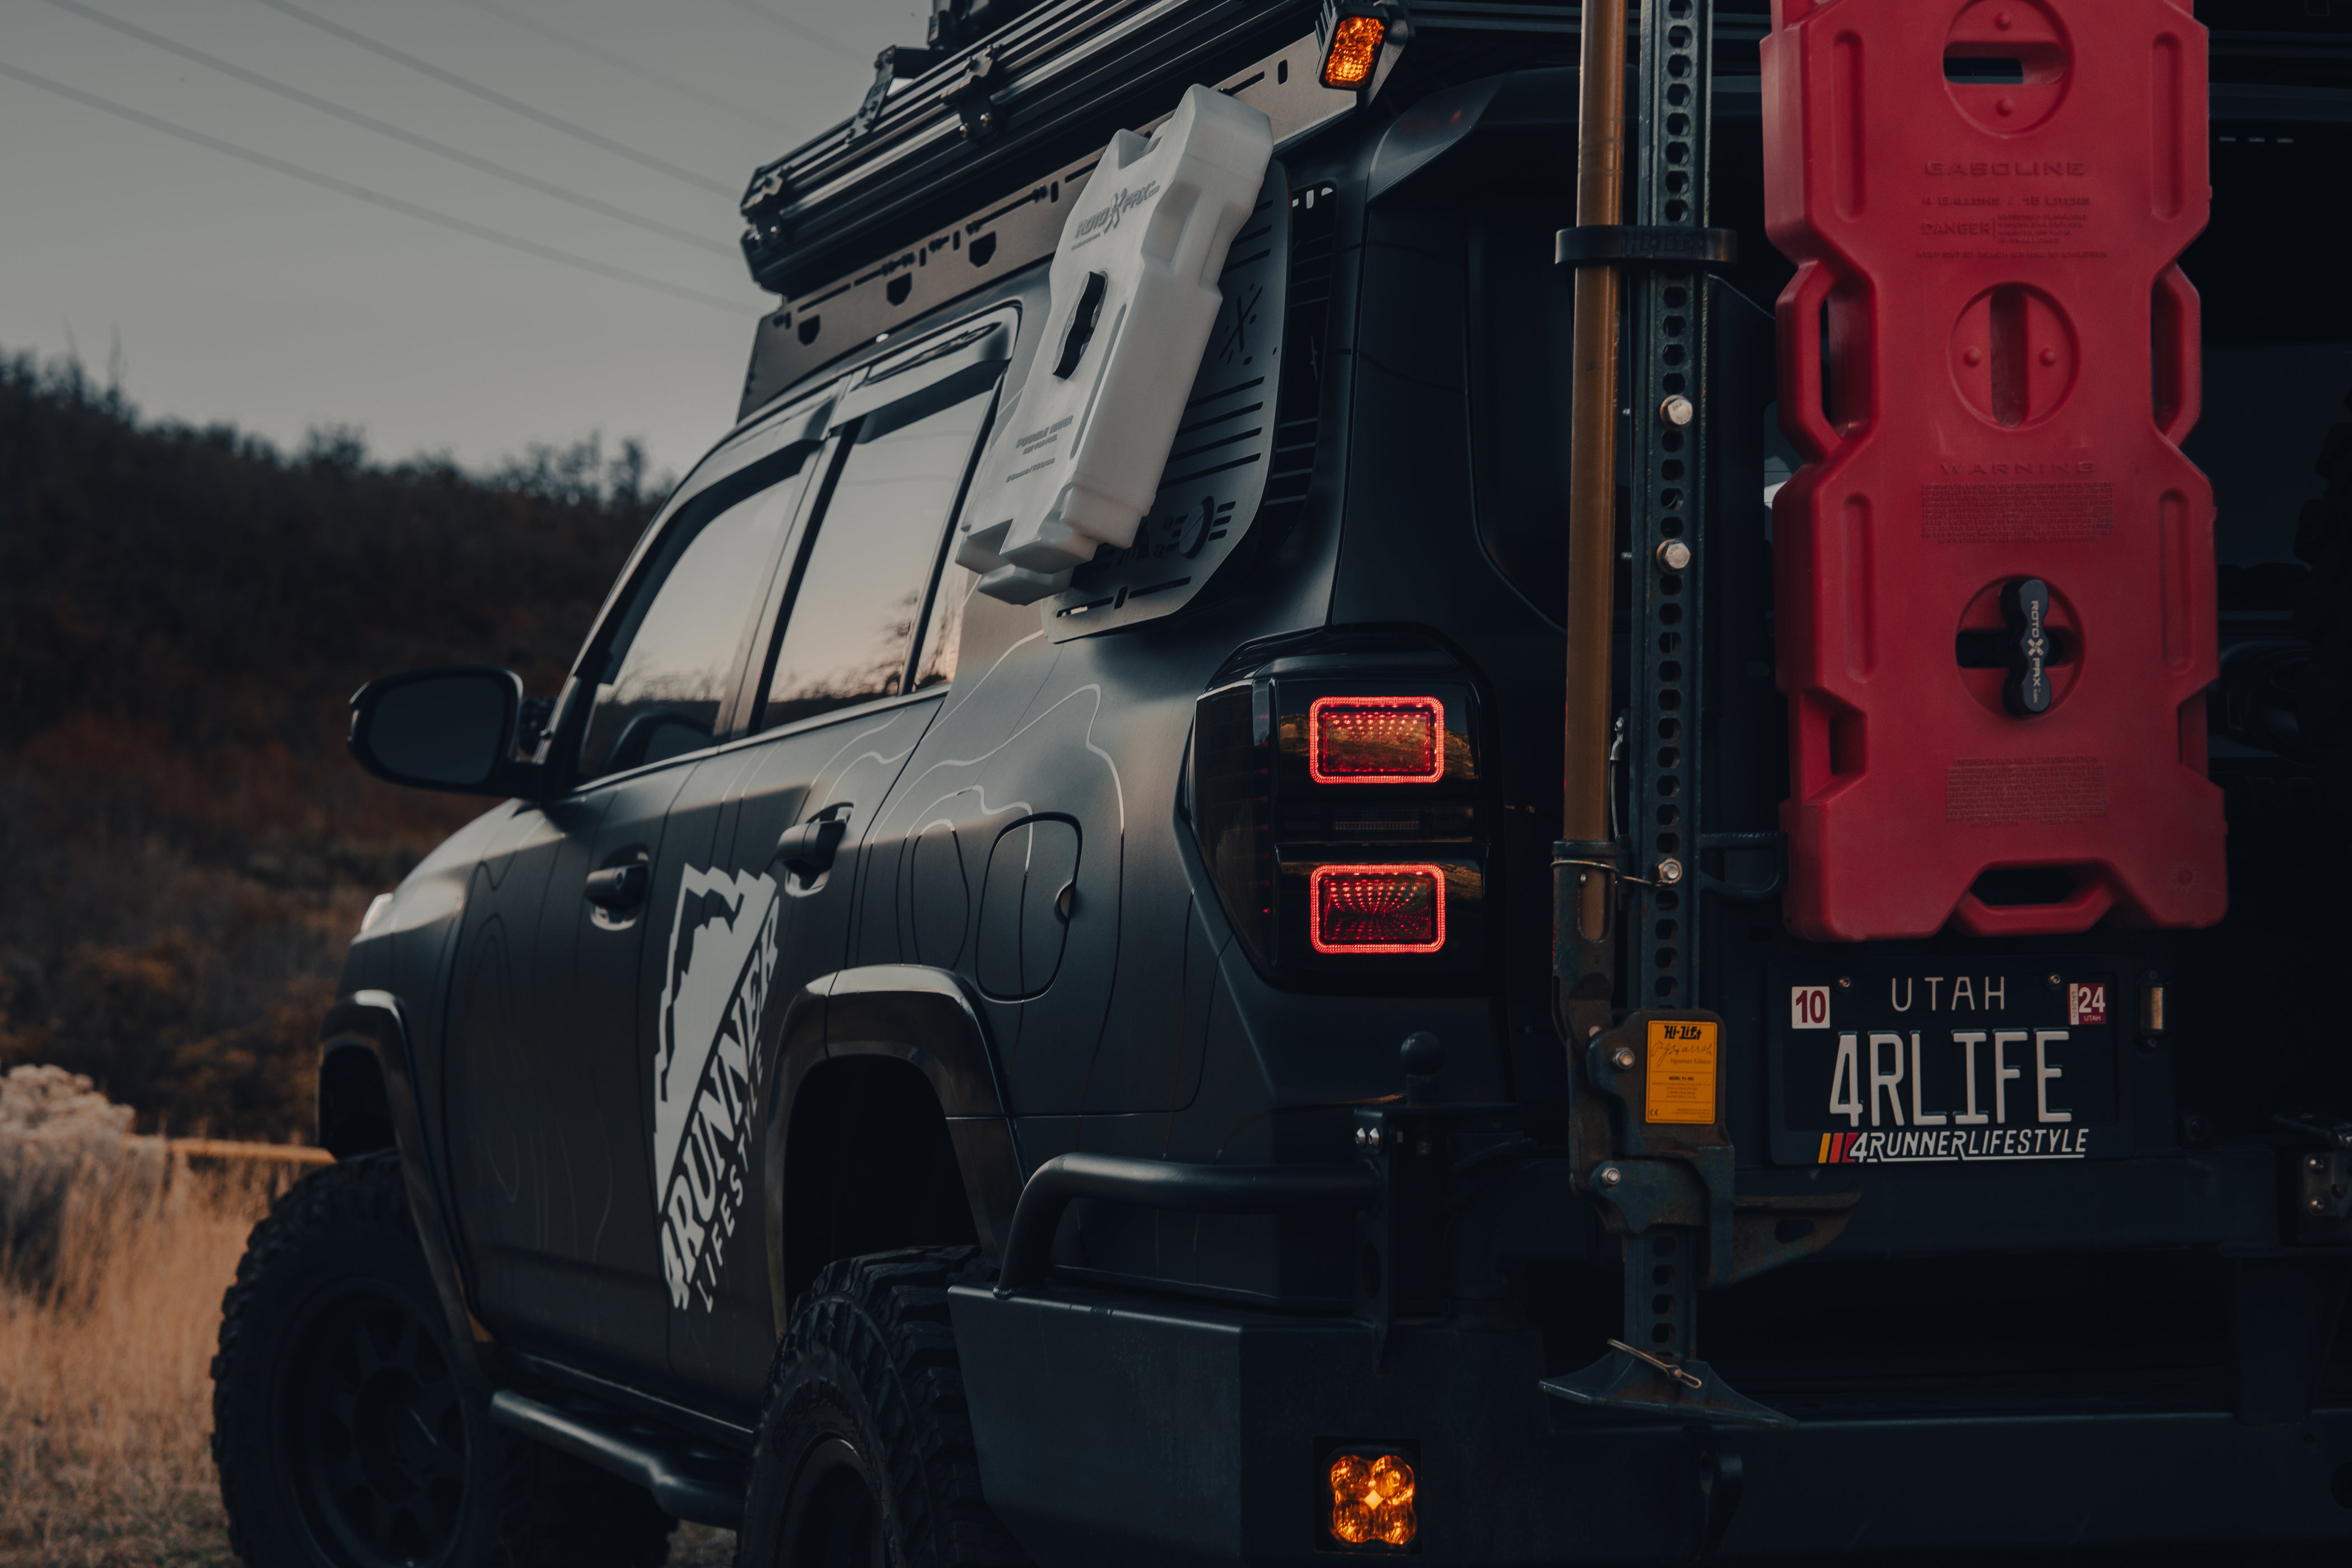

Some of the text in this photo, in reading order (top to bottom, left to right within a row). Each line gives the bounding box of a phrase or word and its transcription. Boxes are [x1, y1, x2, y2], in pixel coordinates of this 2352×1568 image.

[1925, 161, 2084, 176] GASOLINE
[1921, 222, 1990, 235] DANGER
[1940, 461, 2096, 475] WARNING
[1795, 990, 1826, 1024] 10
[1891, 975, 2006, 1012] UTAH
[2078, 987, 2106, 1013] 24
[1828, 1027, 2074, 1127] 4RLIFE
[661, 895, 780, 1312] 4RUNNER
[696, 1040, 764, 1314] LIFESTYLE
